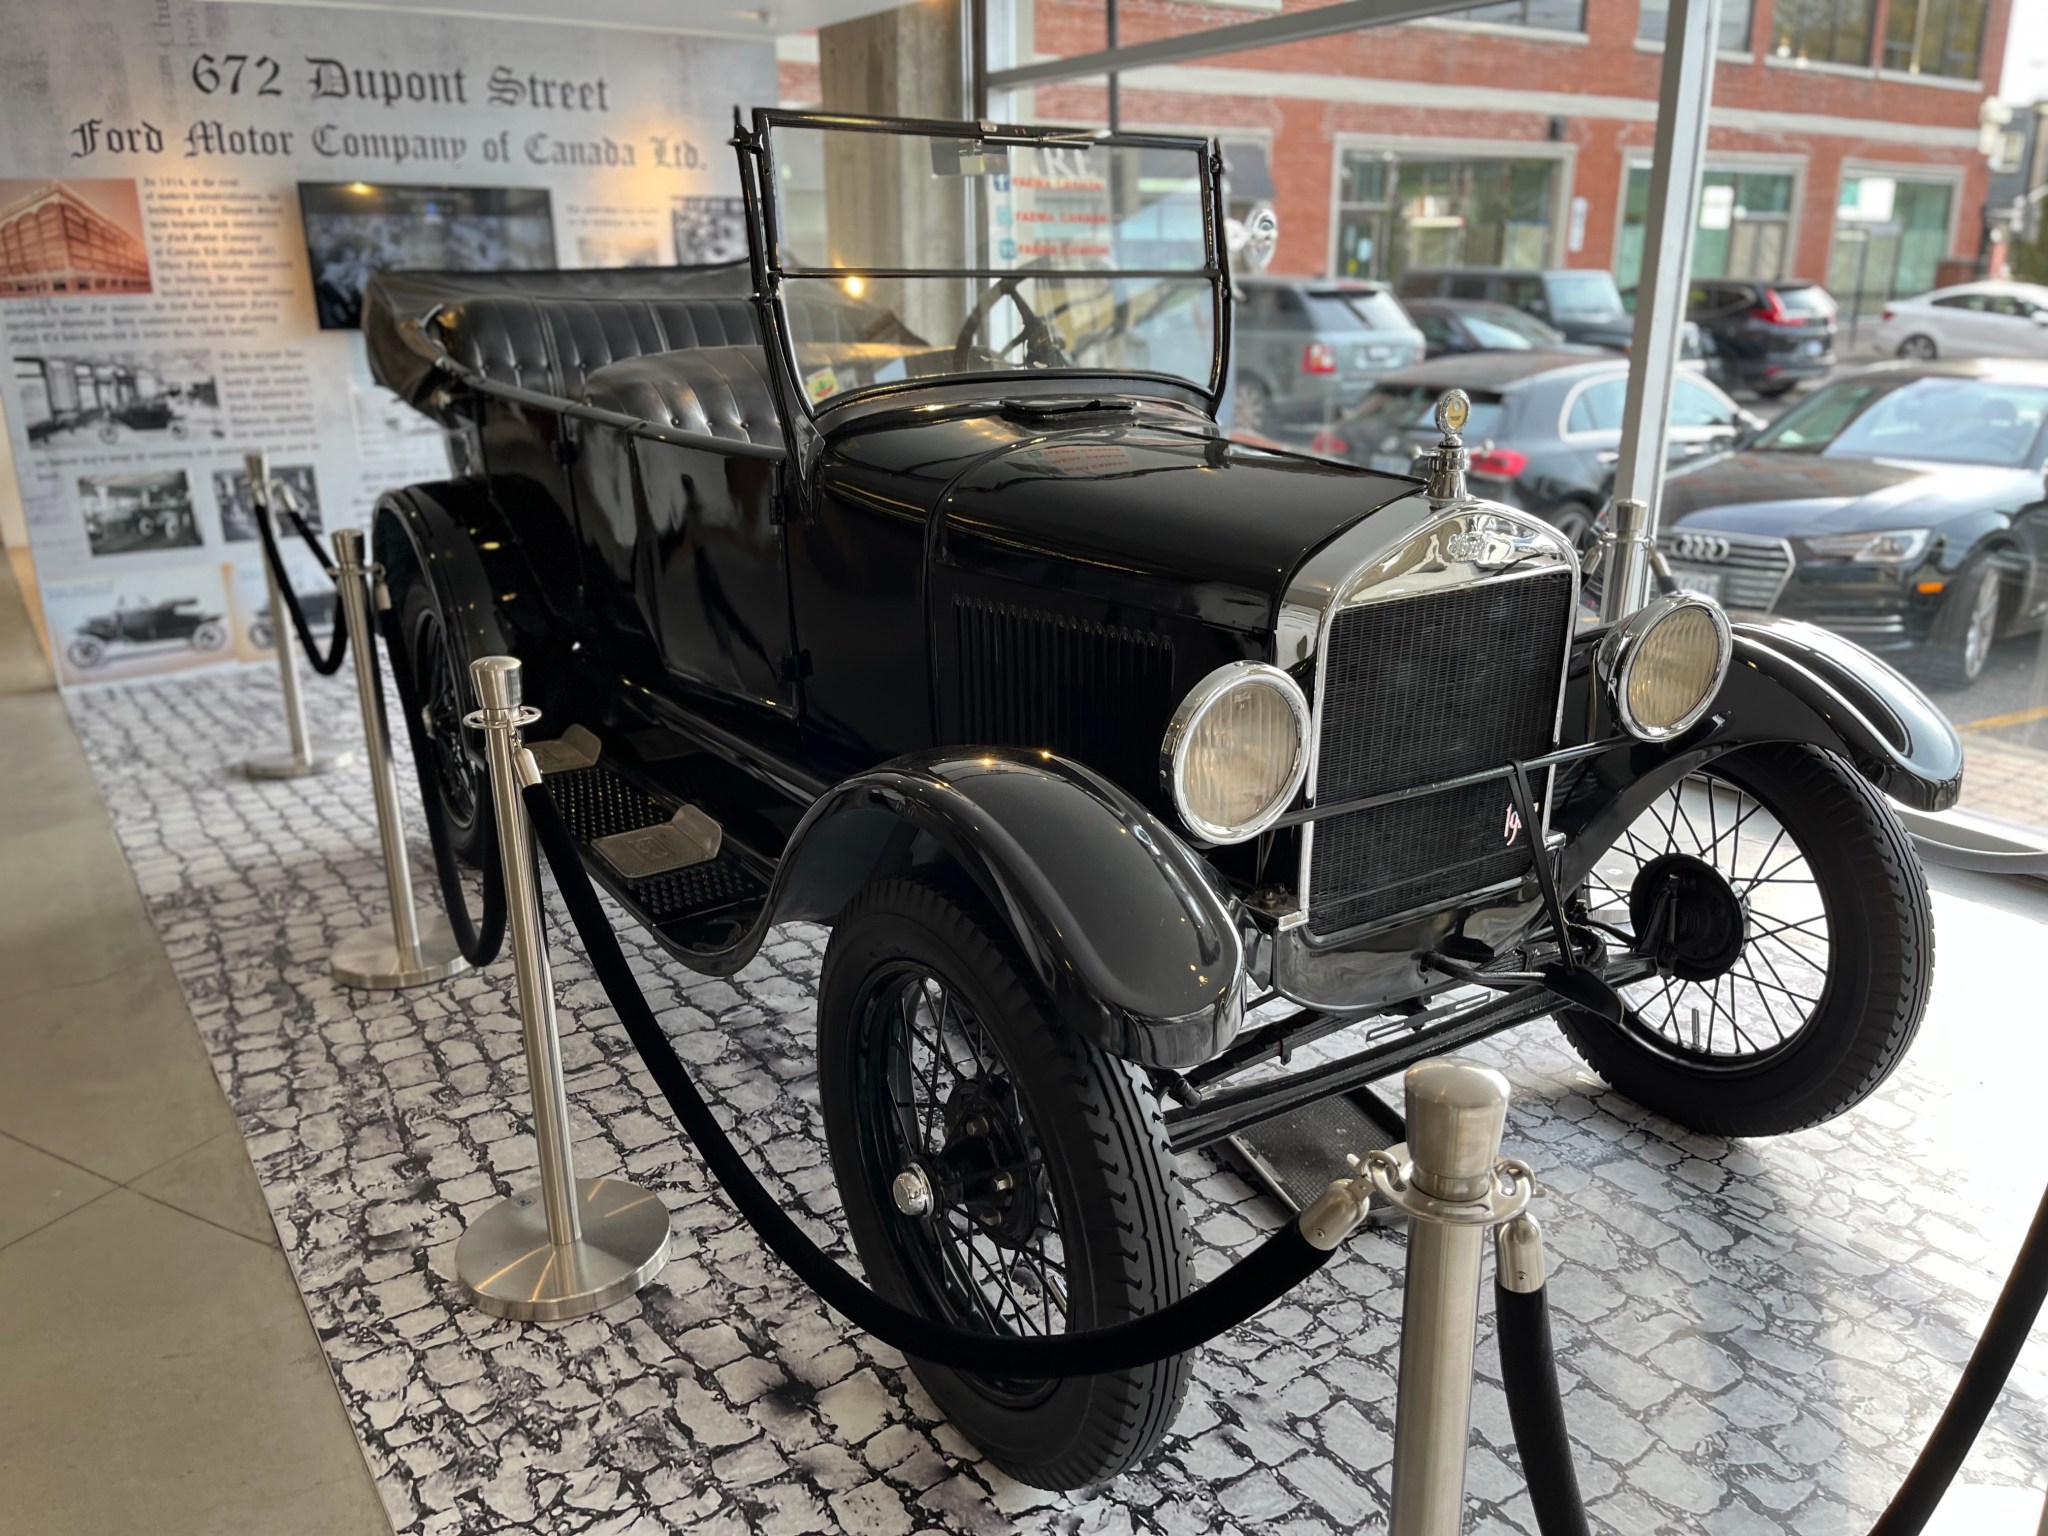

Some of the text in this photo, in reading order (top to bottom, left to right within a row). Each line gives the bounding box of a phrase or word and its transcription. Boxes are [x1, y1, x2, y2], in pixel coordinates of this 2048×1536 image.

[191, 53, 609, 112] 672 Dupont Street
[70, 118, 707, 170] Ford Motor Company of Canada Ltd.
